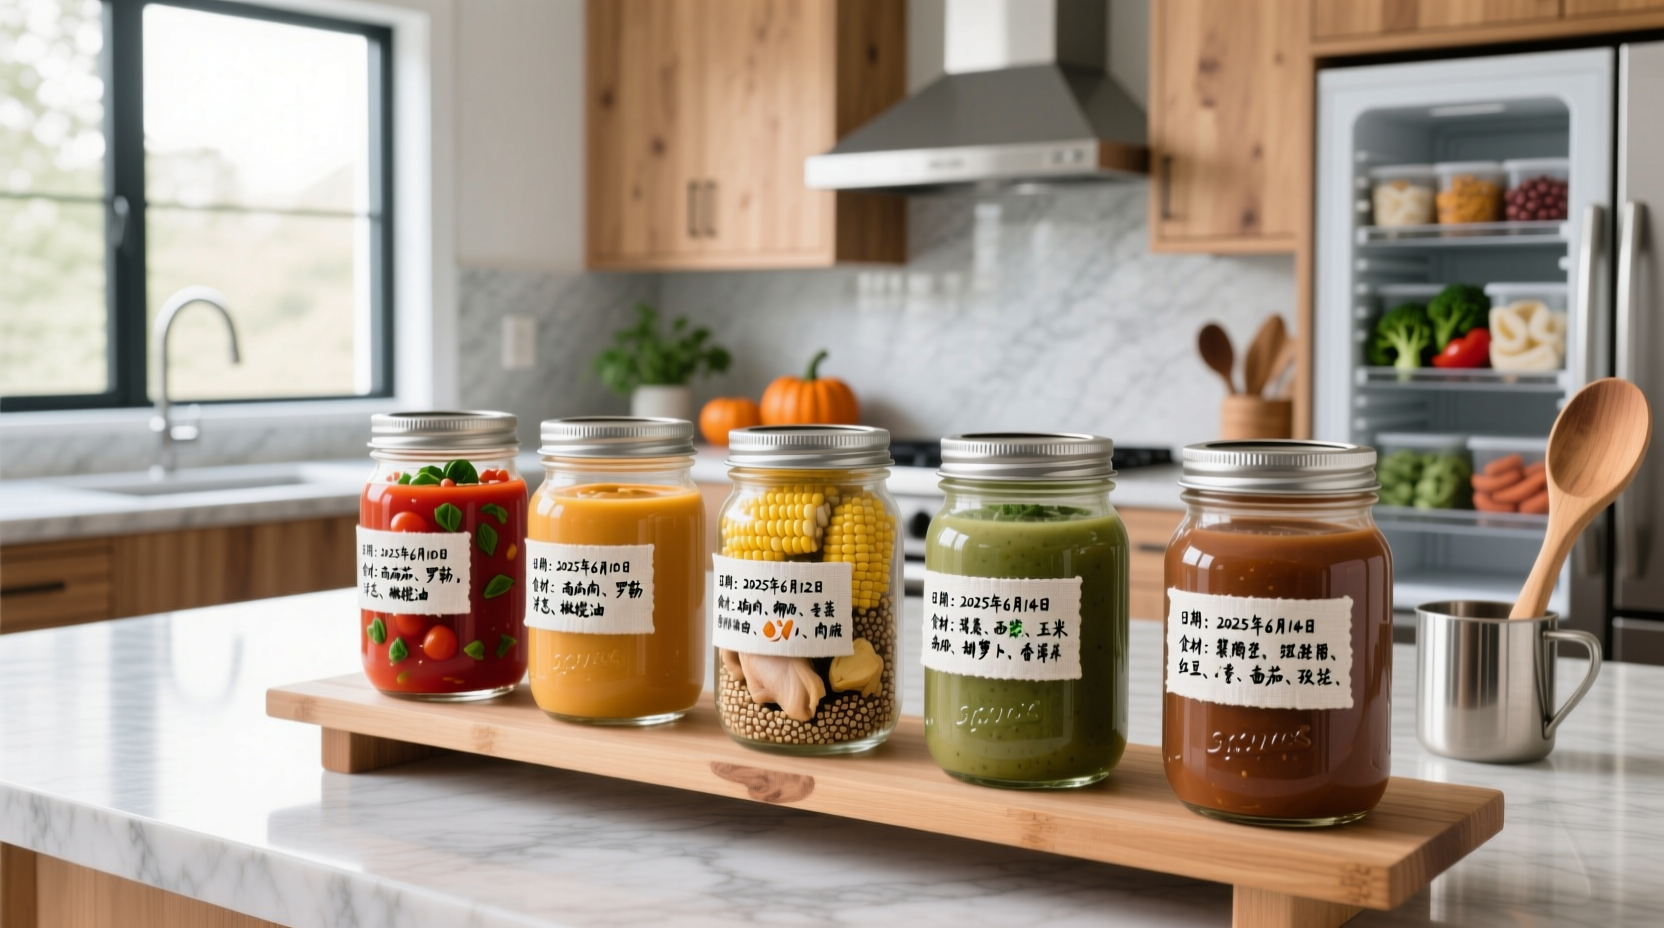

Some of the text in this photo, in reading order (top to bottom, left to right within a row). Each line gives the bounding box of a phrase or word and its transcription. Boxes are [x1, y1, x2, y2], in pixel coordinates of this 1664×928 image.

[1181, 610, 1315, 636] 日期：2025年6月14日
